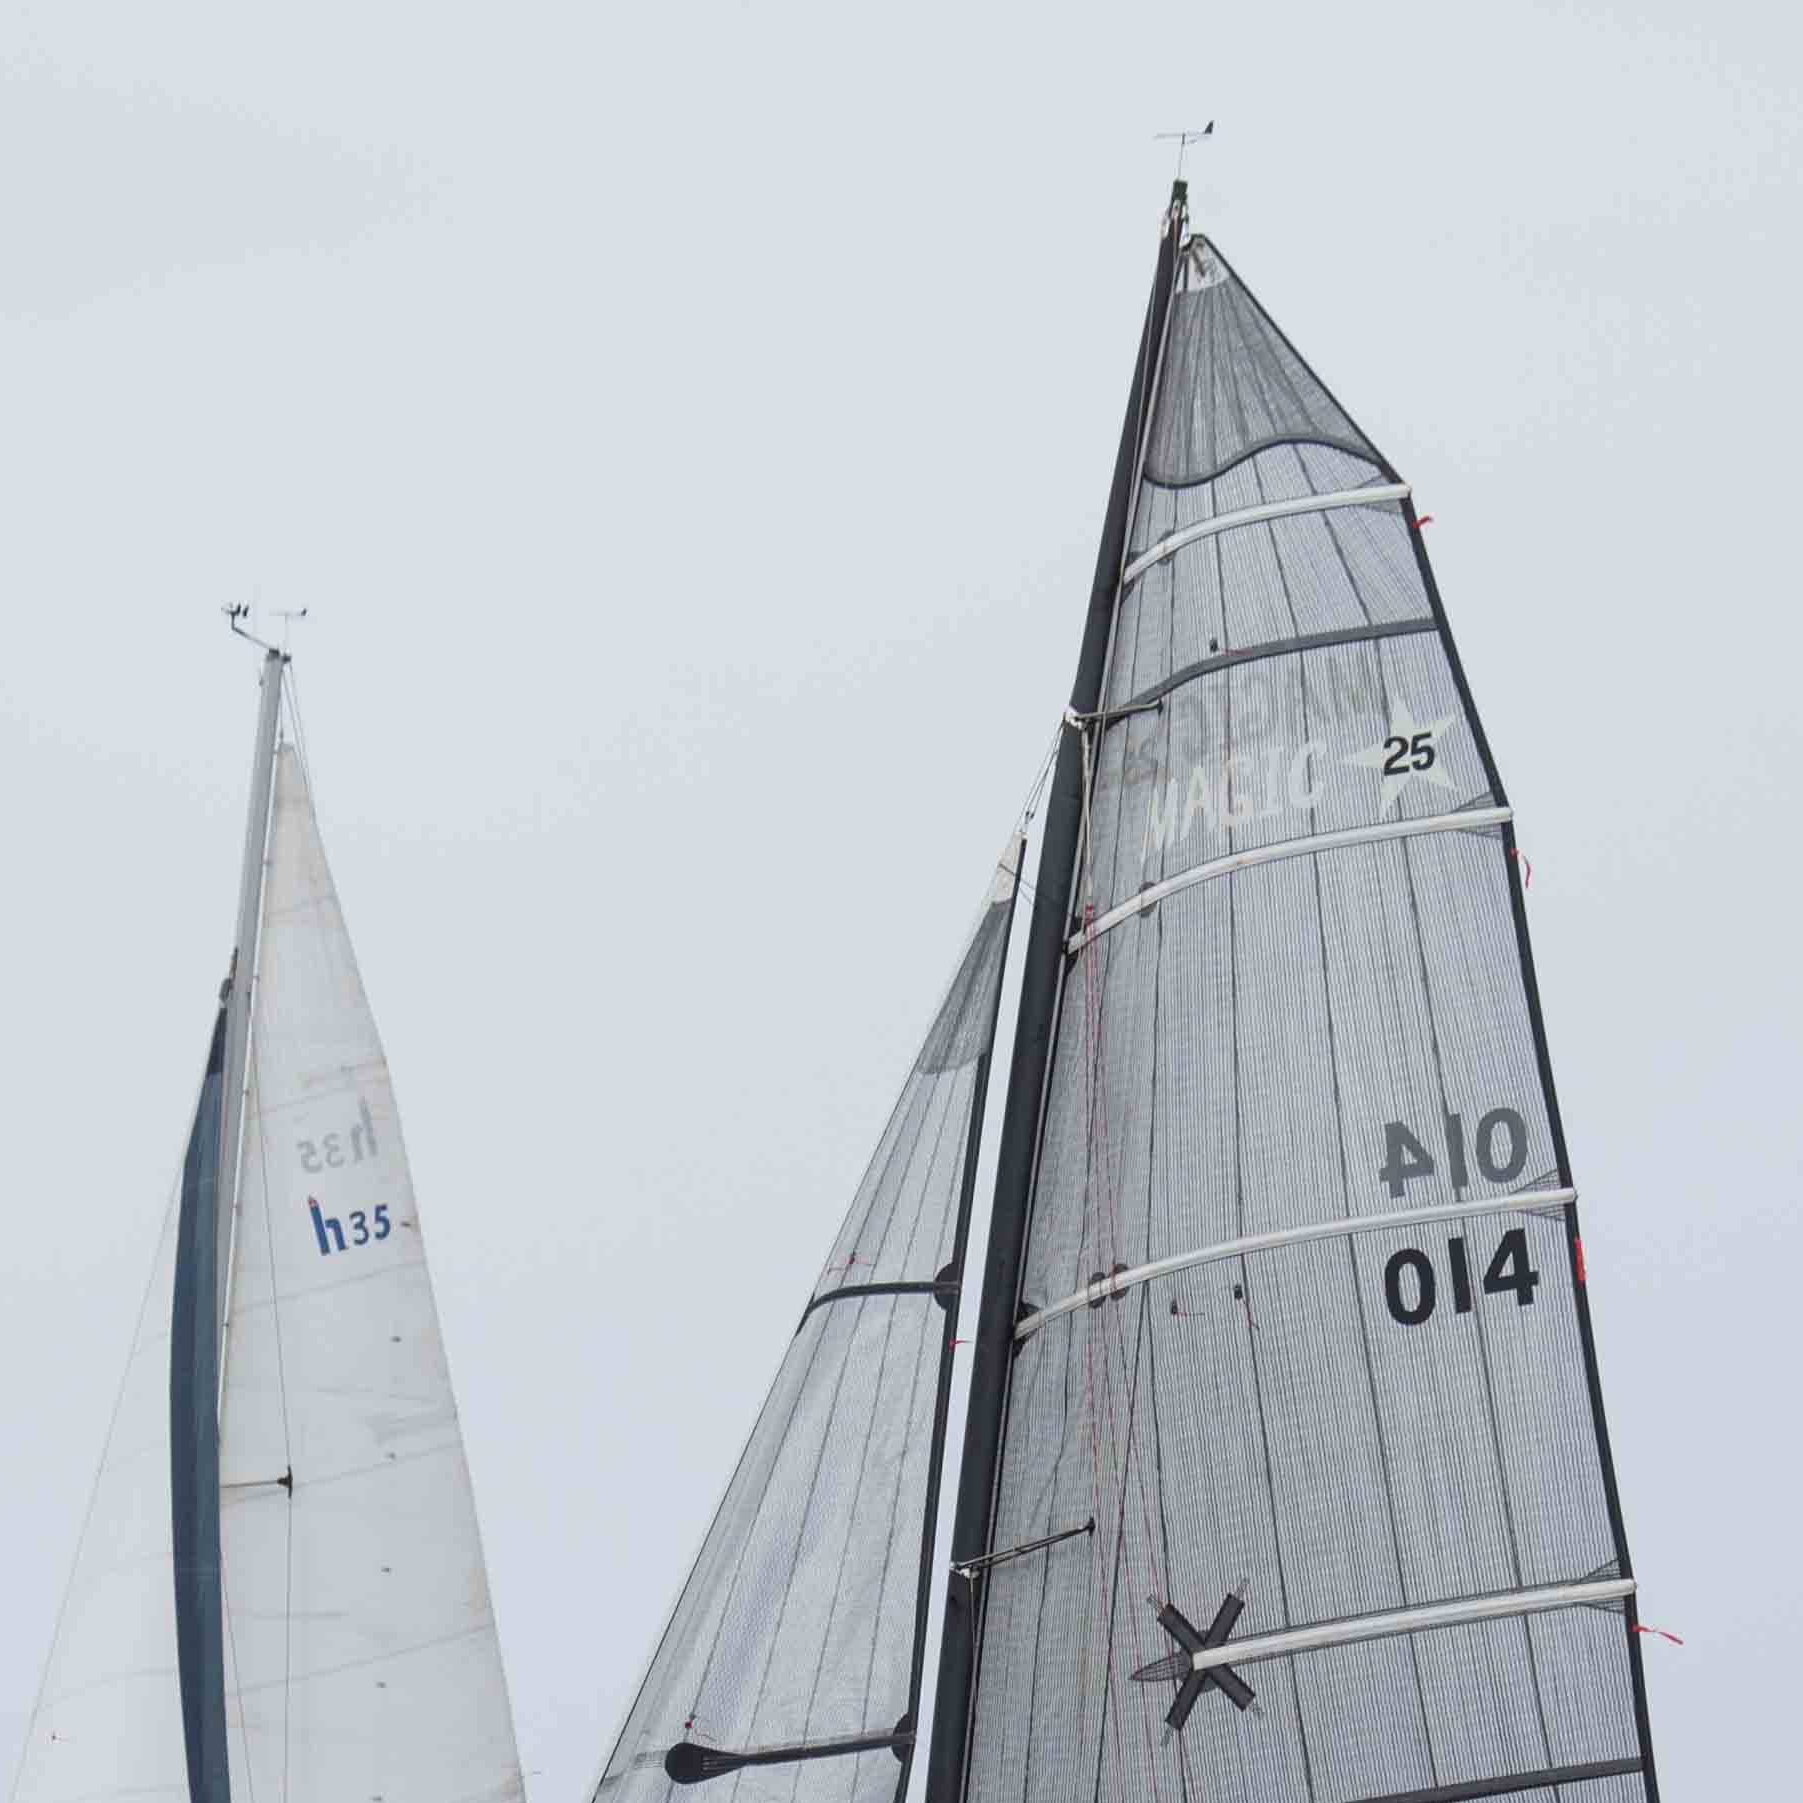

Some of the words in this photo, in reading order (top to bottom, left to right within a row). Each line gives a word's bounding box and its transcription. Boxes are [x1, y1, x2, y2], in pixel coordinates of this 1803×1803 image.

[1140, 739, 1326, 861] MAGIC
[1382, 731, 1436, 776] 25
[1384, 1228, 1539, 1326] 014
